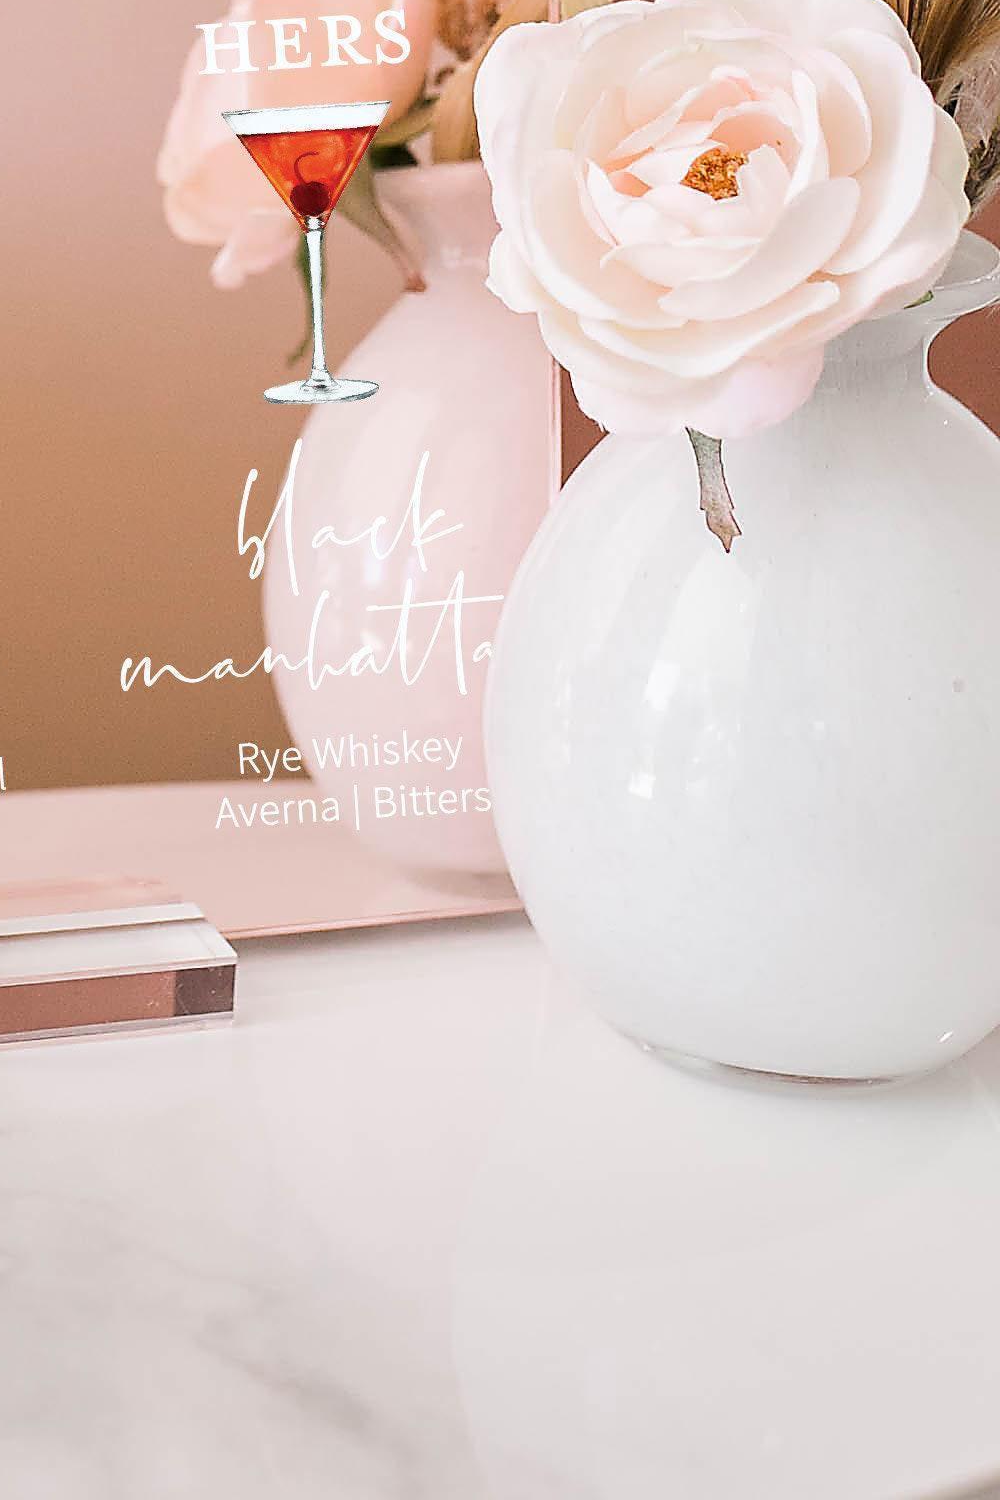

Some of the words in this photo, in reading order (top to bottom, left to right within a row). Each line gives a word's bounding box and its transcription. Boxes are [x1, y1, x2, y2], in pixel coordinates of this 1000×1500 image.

[195, 8, 411, 75] HERS
[237, 438, 464, 596] black
[119, 570, 505, 696] manhatta
[238, 742, 302, 783] Rye
[311, 729, 464, 771] Whiskey
[215, 795, 341, 829] Averna
[374, 783, 493, 819] Bitters
